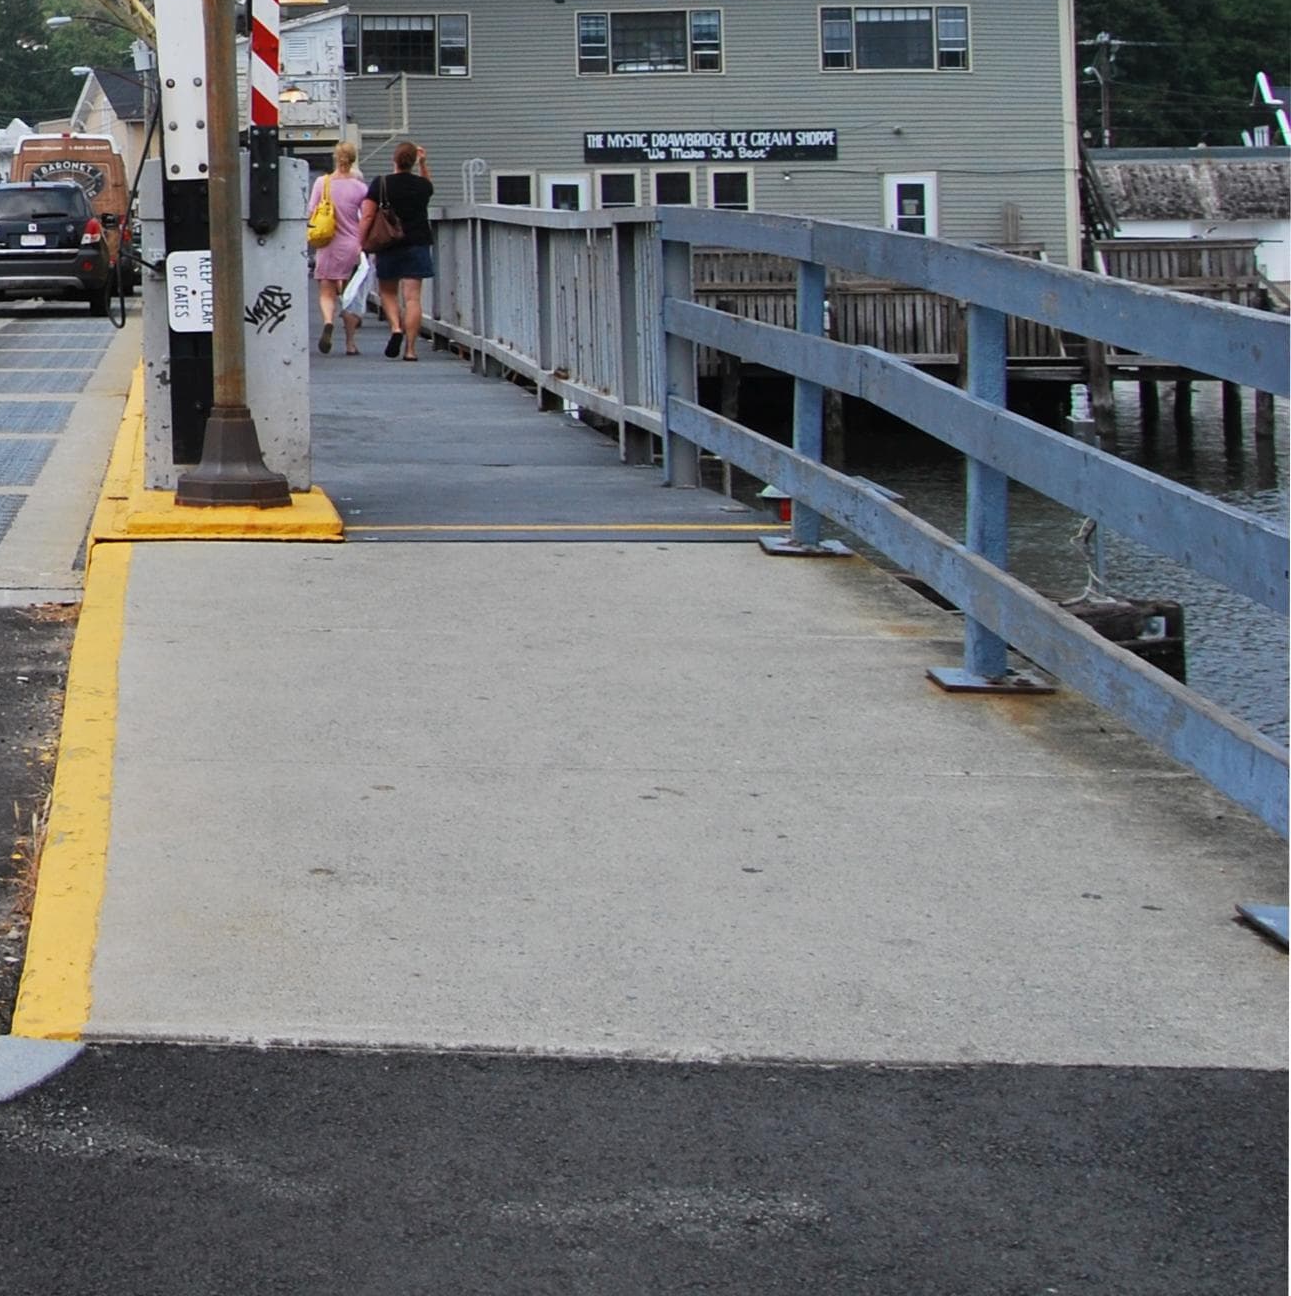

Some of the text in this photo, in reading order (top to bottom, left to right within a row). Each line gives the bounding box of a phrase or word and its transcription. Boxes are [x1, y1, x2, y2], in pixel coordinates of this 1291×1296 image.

[586, 130, 835, 148] THE MYSTIC DRAWBRIDGE ICE CREAM SHOPPE
[669, 148, 705, 159] Make
[711, 147, 734, 159] The
[40, 161, 93, 174] BARONET
[199, 256, 212, 285] KEEP
[173, 265, 189, 318] OF GATES
